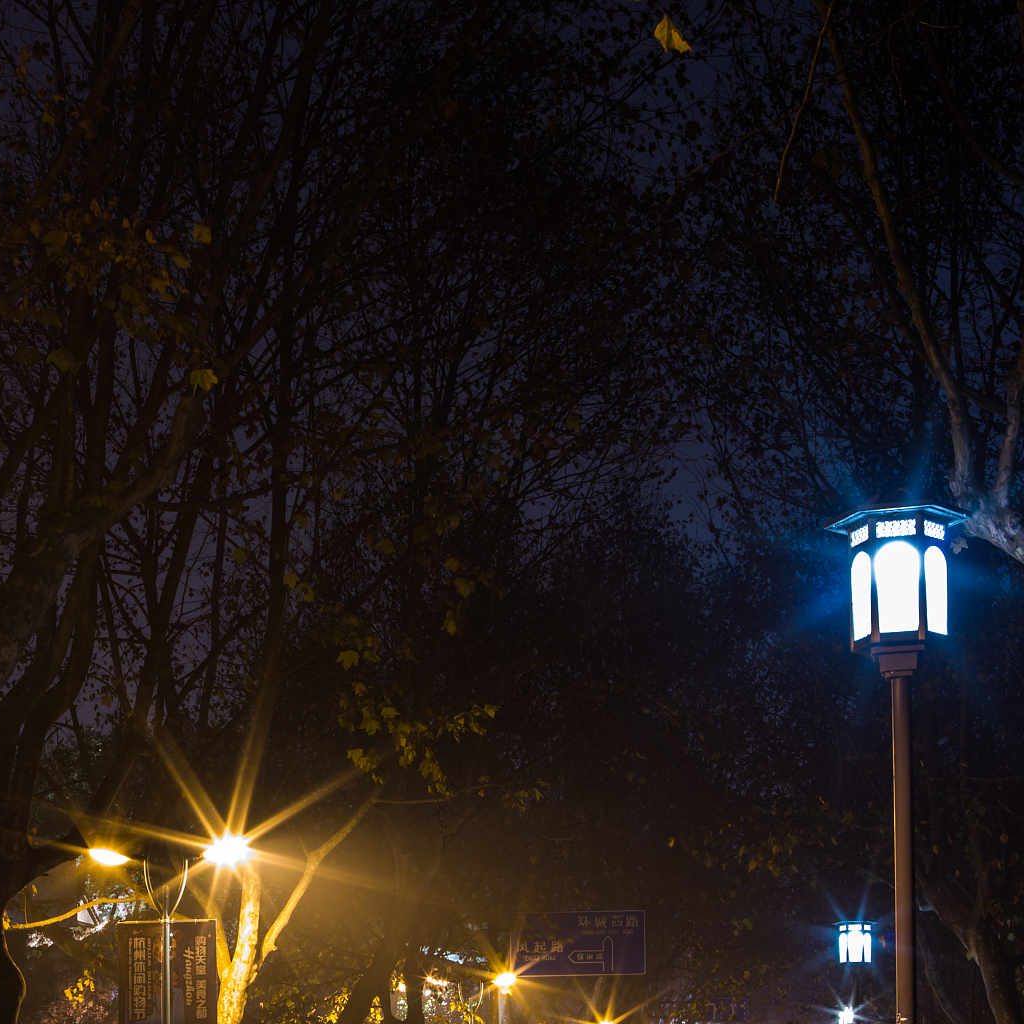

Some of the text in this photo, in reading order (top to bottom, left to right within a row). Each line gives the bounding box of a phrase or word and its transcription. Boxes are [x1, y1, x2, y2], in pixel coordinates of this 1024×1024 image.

[516, 940, 564, 953] 凤起路
[577, 915, 639, 928] 环城西路
[133, 937, 146, 1020] 杭州休闲购物节
[182, 946, 195, 1006] Hangzhou
[195, 936, 207, 1019] 购物天堂 美食之都
